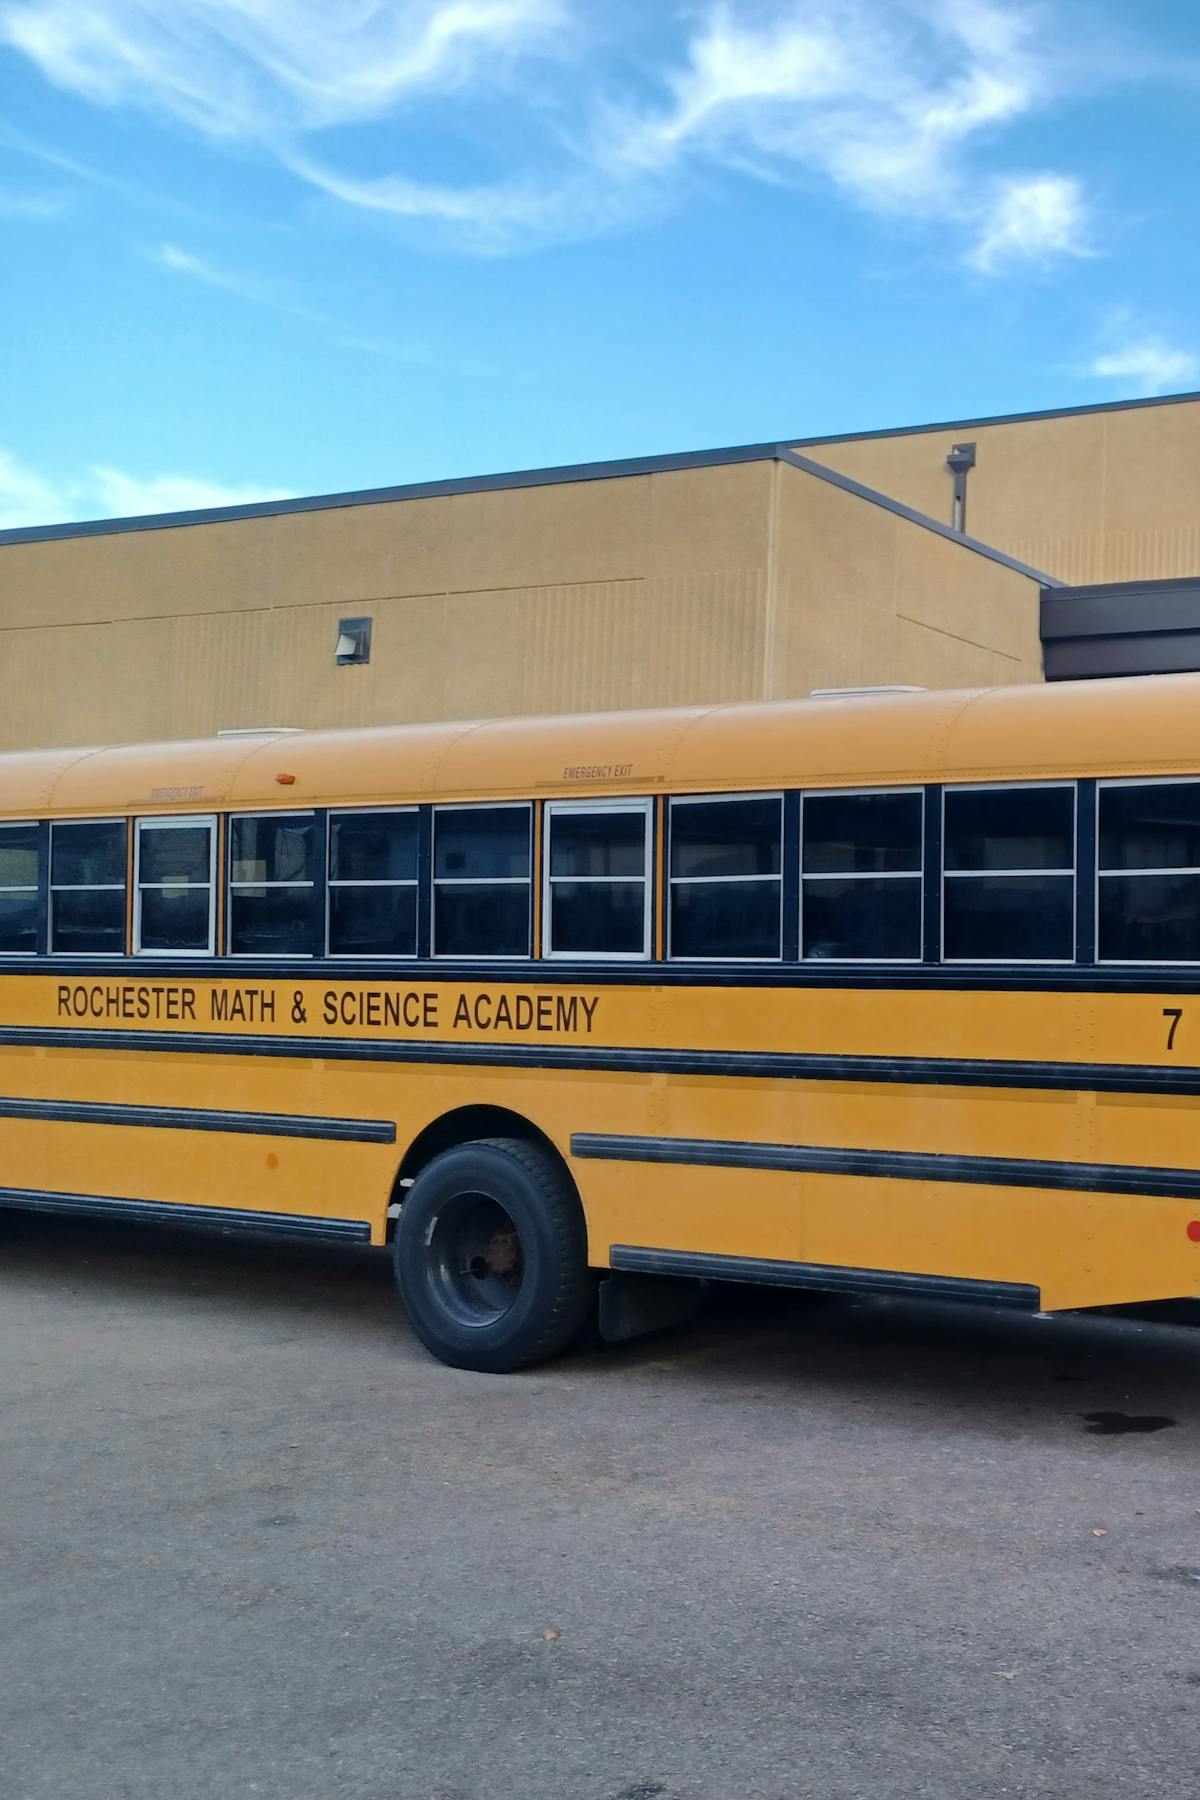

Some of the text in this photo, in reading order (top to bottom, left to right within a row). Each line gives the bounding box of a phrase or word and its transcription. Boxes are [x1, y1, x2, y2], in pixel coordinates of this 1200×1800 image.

[563, 764, 633, 779] EMERGENCY EXIT
[58, 985, 599, 1033] ROCHESTER MATH & SCIENCE ACADEMY
[1163, 1008, 1182, 1050] 7
